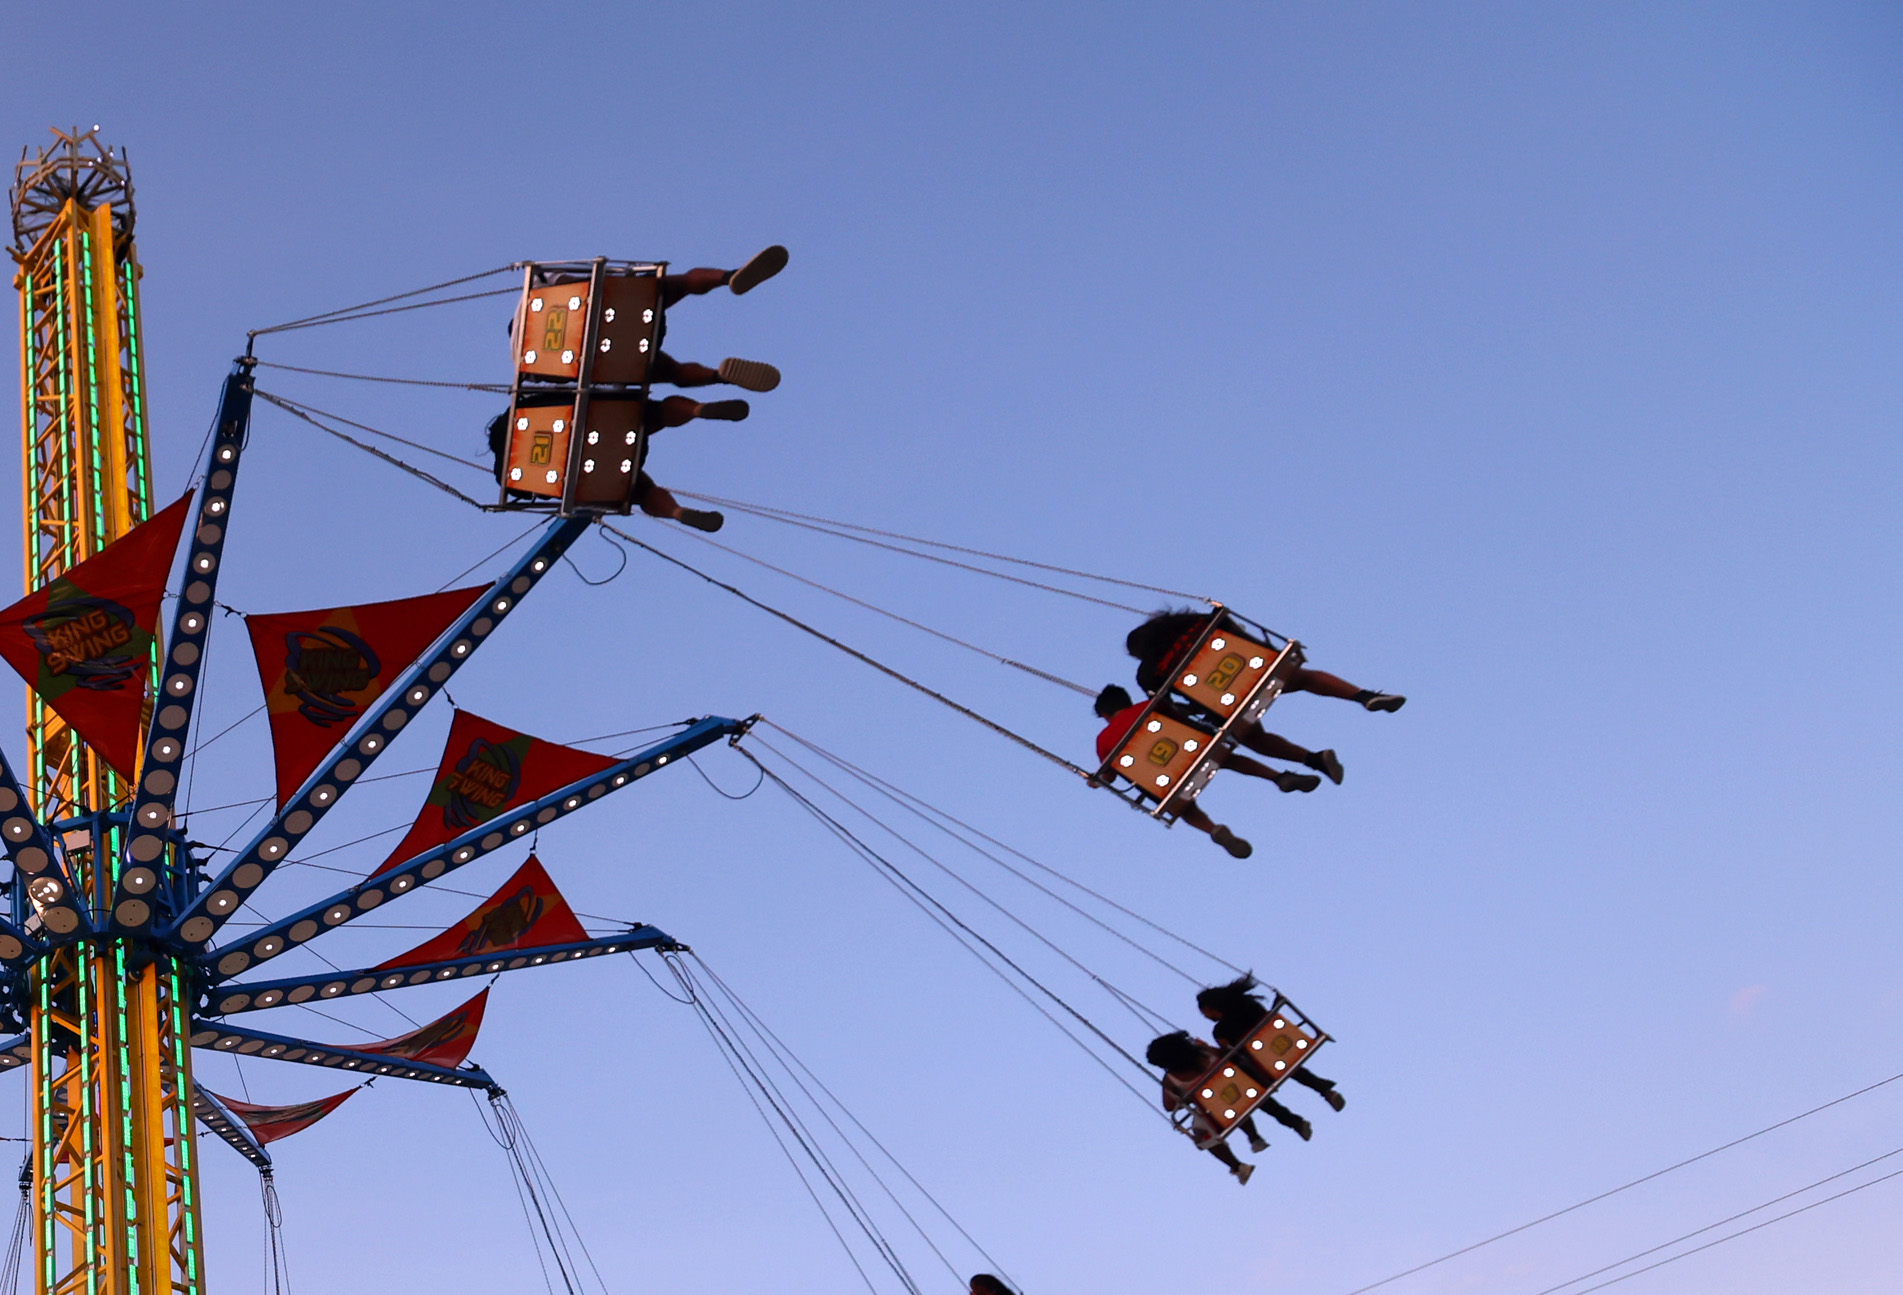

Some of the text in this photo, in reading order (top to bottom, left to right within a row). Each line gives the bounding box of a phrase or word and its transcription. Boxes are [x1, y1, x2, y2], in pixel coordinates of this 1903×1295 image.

[46, 608, 109, 649] KING
[46, 620, 130, 676] SWING
[1204, 652, 1246, 692] 20
